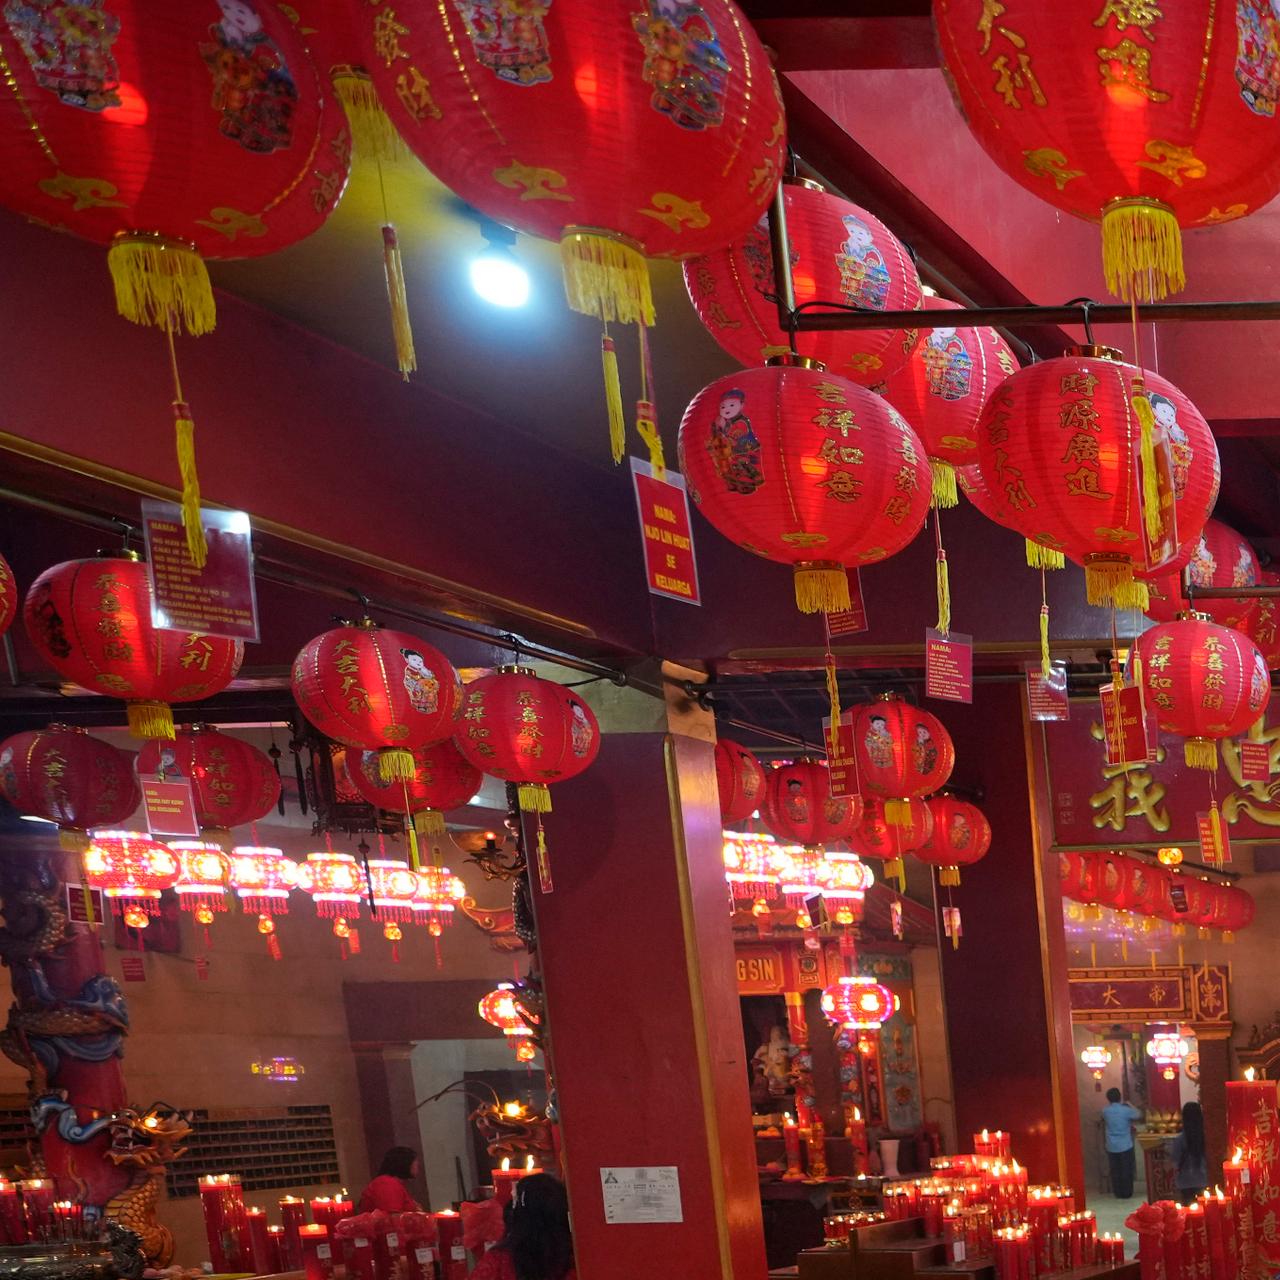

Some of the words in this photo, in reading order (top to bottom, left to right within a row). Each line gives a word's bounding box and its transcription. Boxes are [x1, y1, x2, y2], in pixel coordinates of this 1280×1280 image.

[812, 381, 865, 503] 吉祥如意
[1058, 373, 1113, 500] 財源廣進
[1202, 636, 1228, 710] 恭喜發財
[749, 958, 775, 981] SIN
